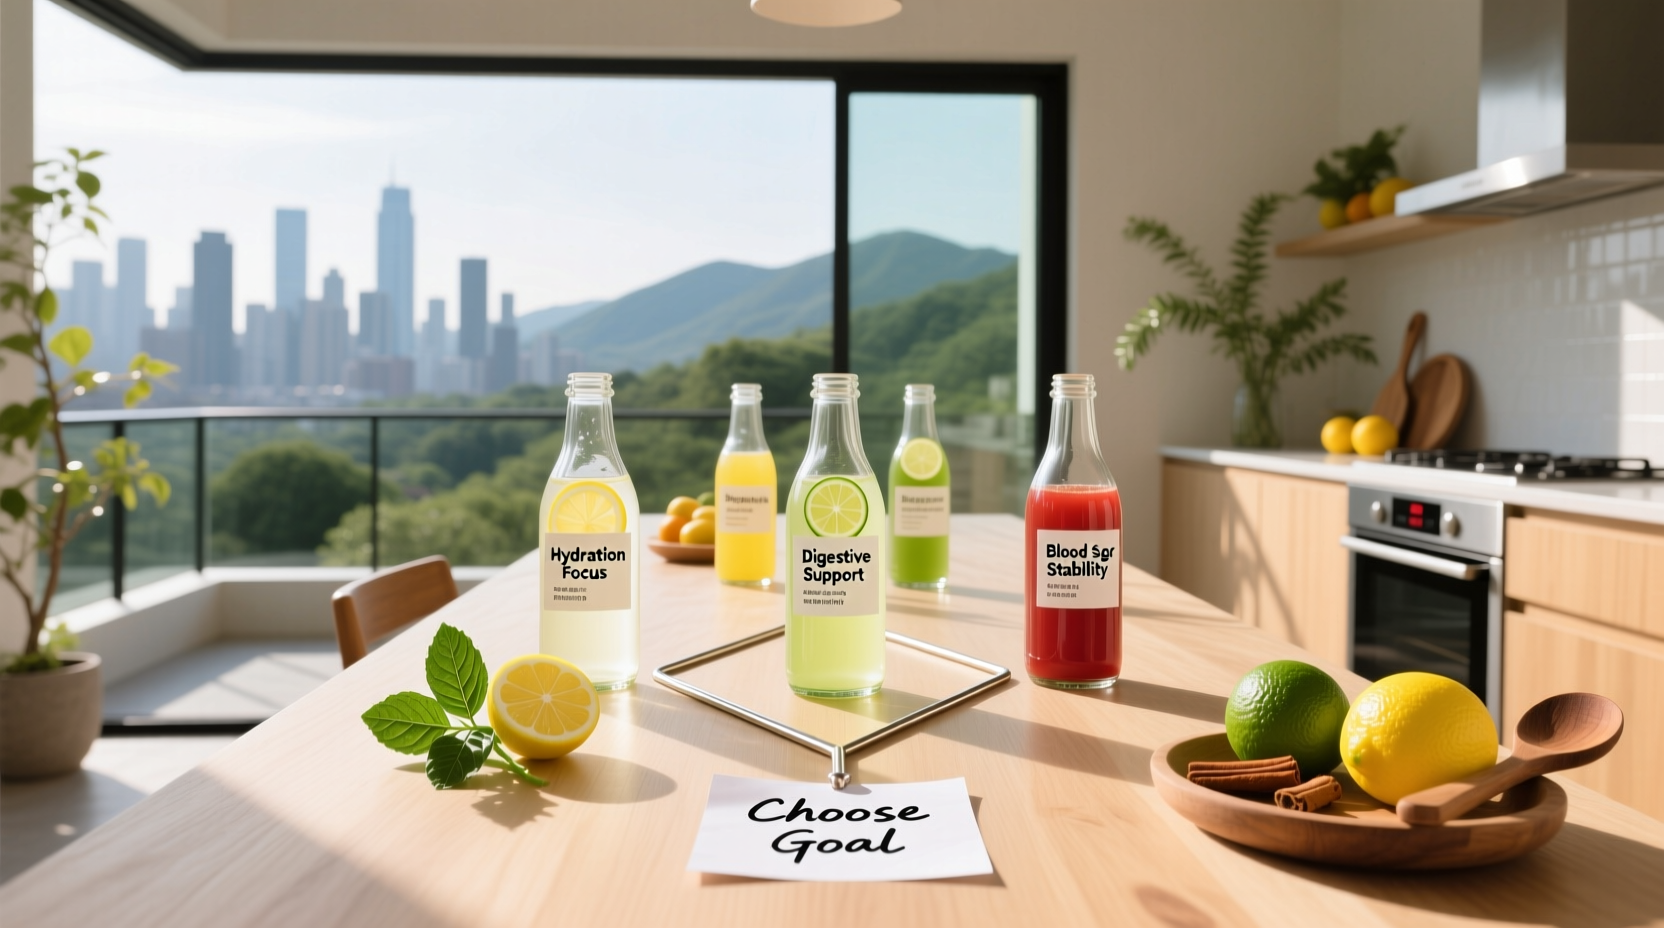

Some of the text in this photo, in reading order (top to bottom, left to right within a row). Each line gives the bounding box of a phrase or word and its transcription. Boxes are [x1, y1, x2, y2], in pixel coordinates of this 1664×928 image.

[551, 547, 626, 566] Hydration
[802, 548, 871, 568] Digestive
[1046, 543, 1088, 559] Blood
[562, 565, 608, 580] Focus
[803, 567, 864, 586] Support
[748, 798, 930, 823] Choose
[771, 828, 906, 865] Goal
